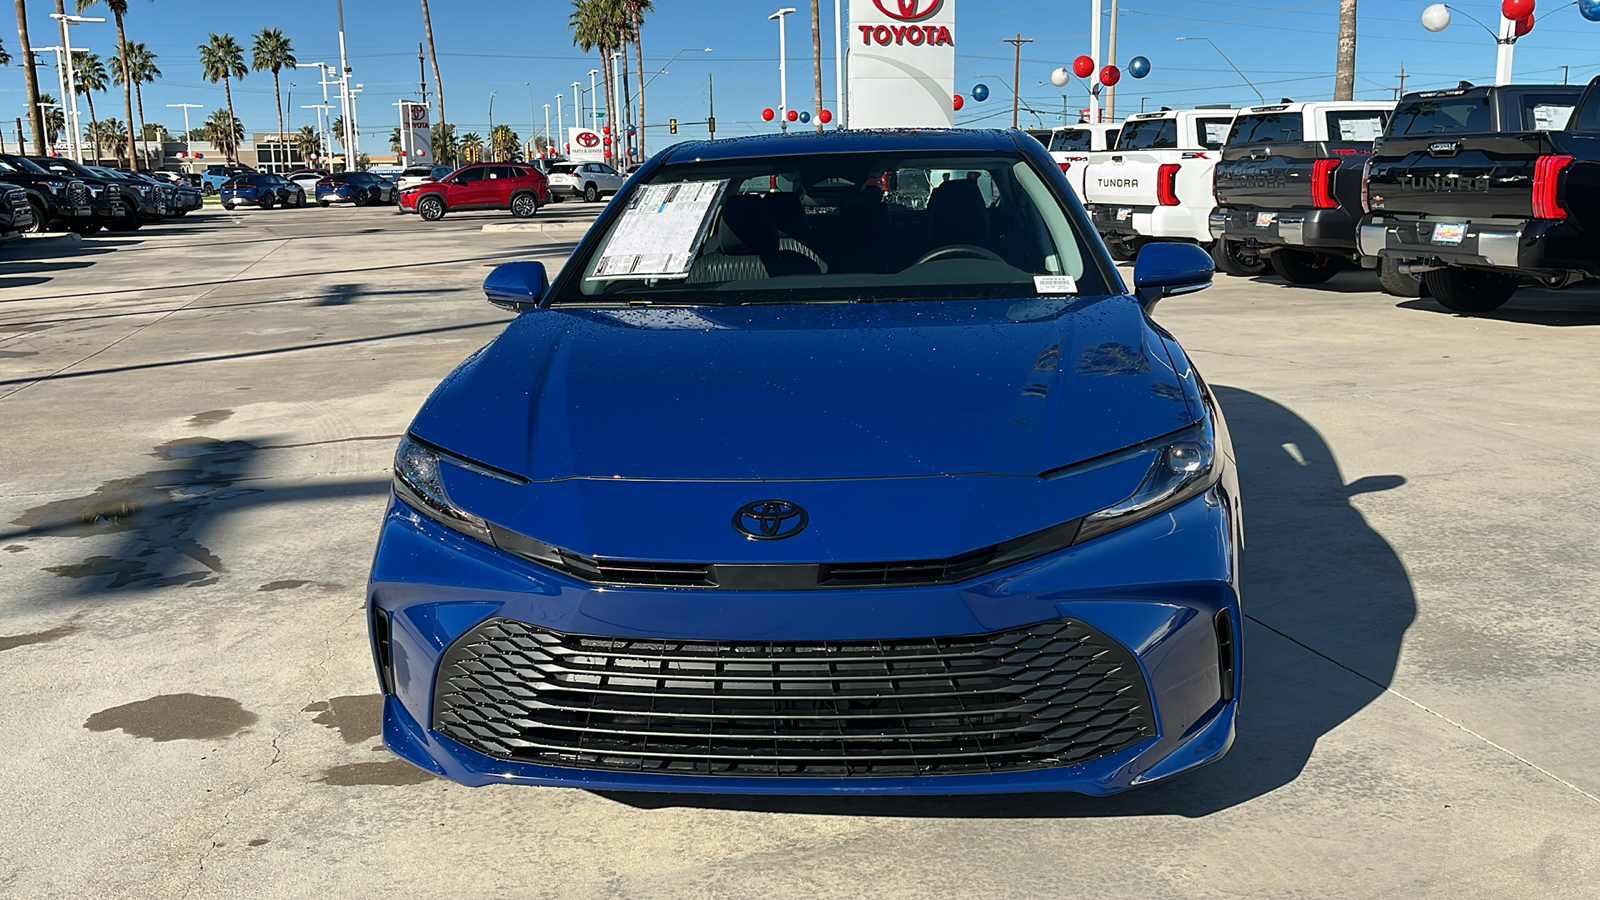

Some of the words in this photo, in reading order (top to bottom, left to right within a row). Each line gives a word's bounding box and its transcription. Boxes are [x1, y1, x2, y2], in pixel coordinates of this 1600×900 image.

[858, 25, 954, 46] TOYOTA
[1332, 148, 1357, 156] TRD
[1098, 178, 1139, 188] TUNDRA
[1232, 176, 1287, 188] TUNDRA
[1396, 176, 1490, 191] TUNDRA
